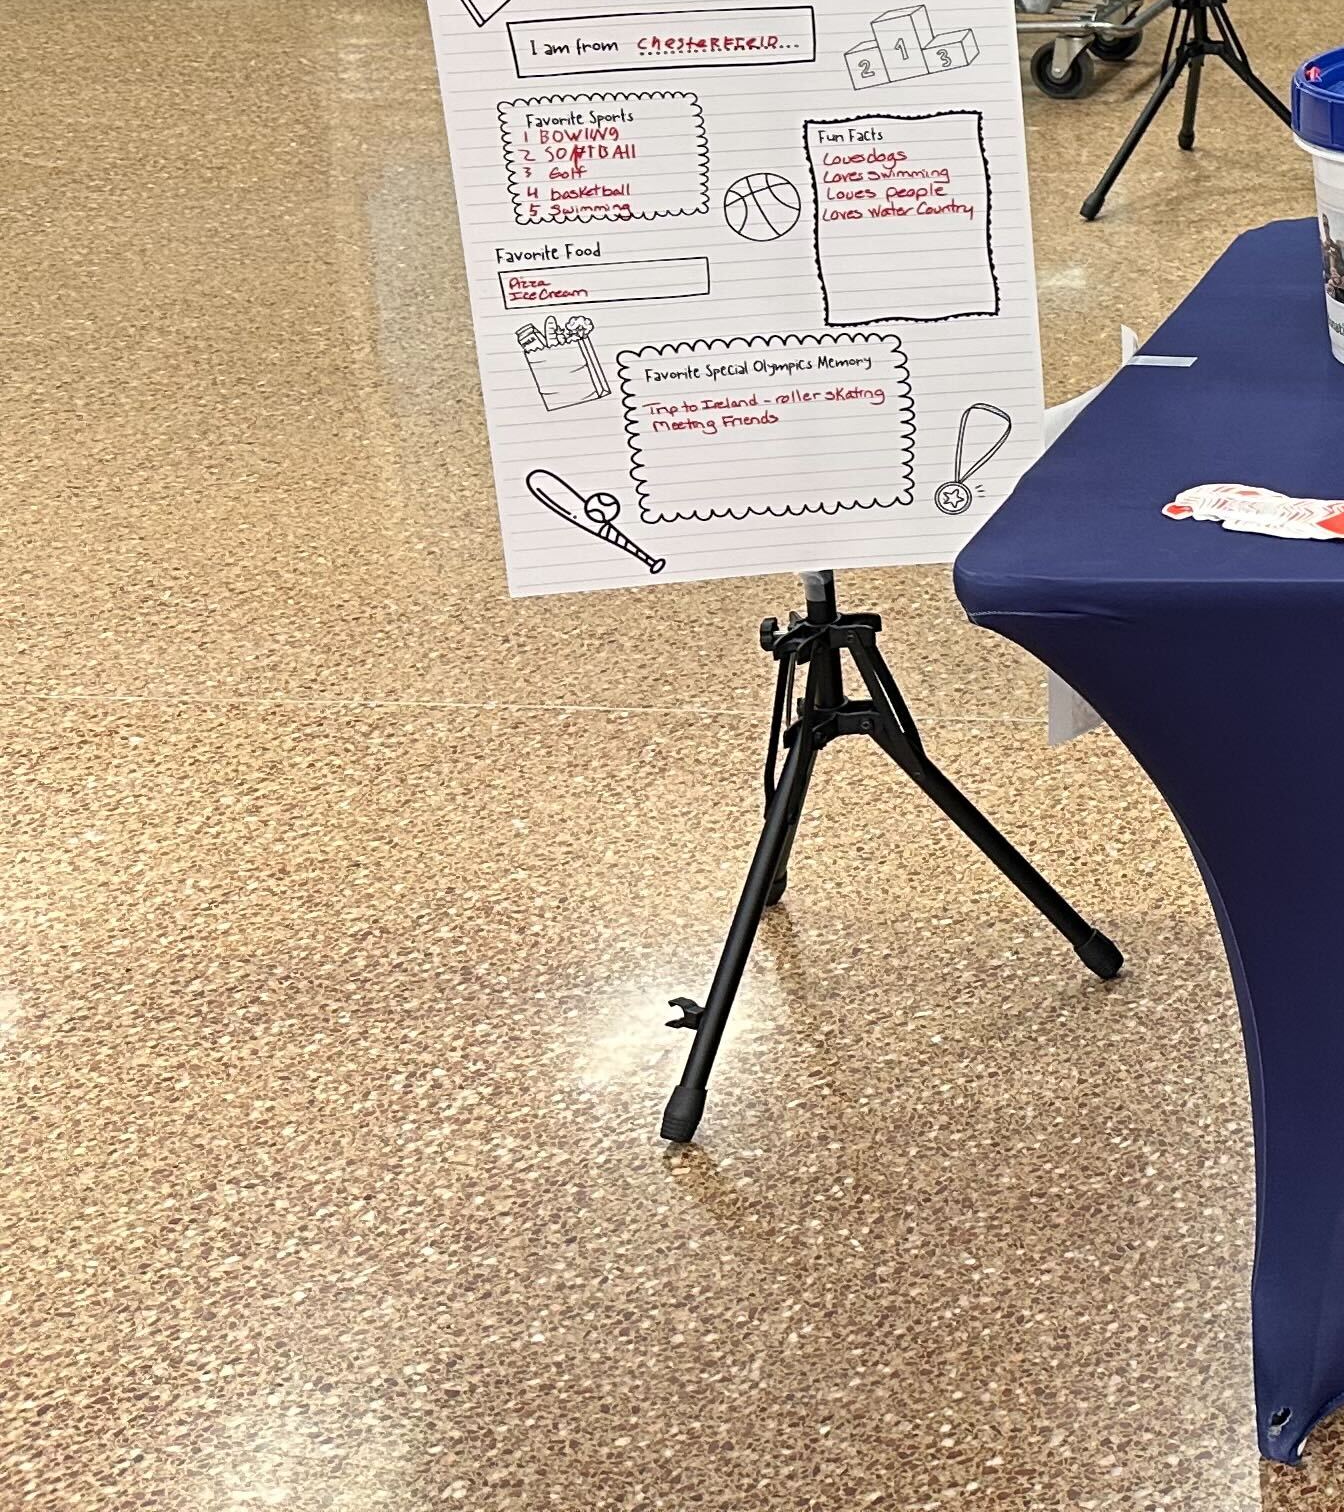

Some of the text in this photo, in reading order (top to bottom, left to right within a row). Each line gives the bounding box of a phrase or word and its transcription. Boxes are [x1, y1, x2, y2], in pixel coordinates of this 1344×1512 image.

[531, 38, 619, 56] I am from
[526, 108, 634, 129] Favorite Sports
[818, 127, 884, 143] Fun Facts
[885, 182, 948, 202] people
[495, 242, 602, 264] Favorite Food
[645, 355, 873, 383] Favorite Special Olympics Memory
